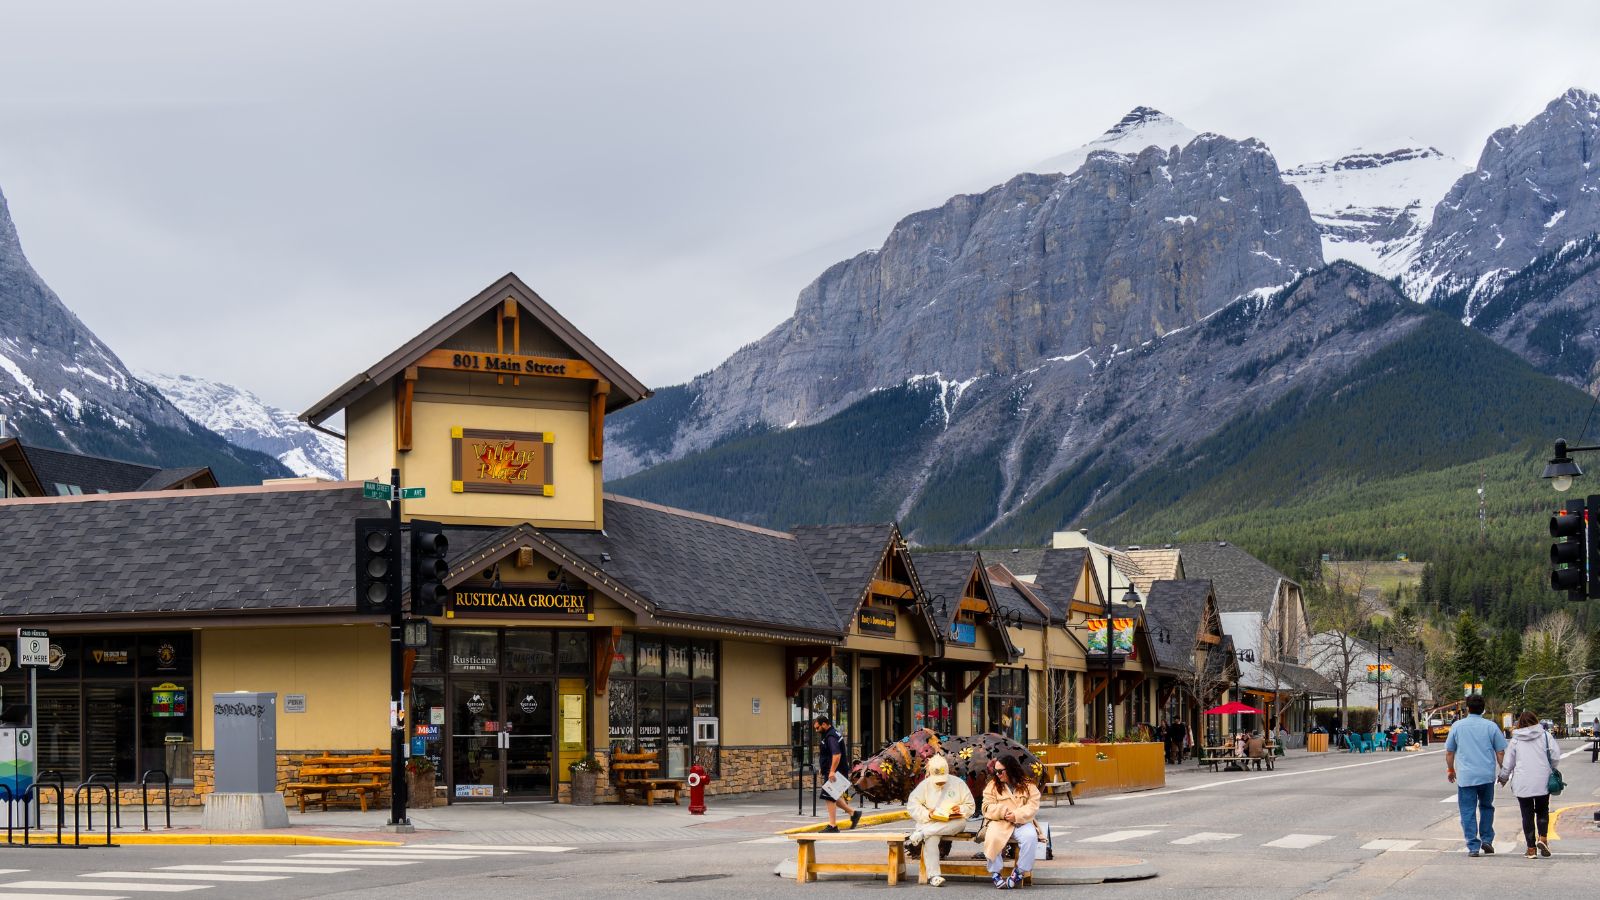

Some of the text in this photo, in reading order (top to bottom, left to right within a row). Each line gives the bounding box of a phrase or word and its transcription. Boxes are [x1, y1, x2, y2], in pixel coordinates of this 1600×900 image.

[453, 354, 566, 375] 801 Main Street
[472, 442, 535, 469] Village
[478, 462, 528, 481] Plaza
[376, 484, 390, 492] STREET
[403, 490, 408, 498] 7
[455, 592, 586, 609] RUSTICANA GROCERY
[34, 655, 48, 663] HERE
[453, 655, 497, 664] Rusticana
[418, 726, 438, 734] M&M
[625, 726, 634, 735] GO
[640, 726, 661, 735] ESPRESSO
